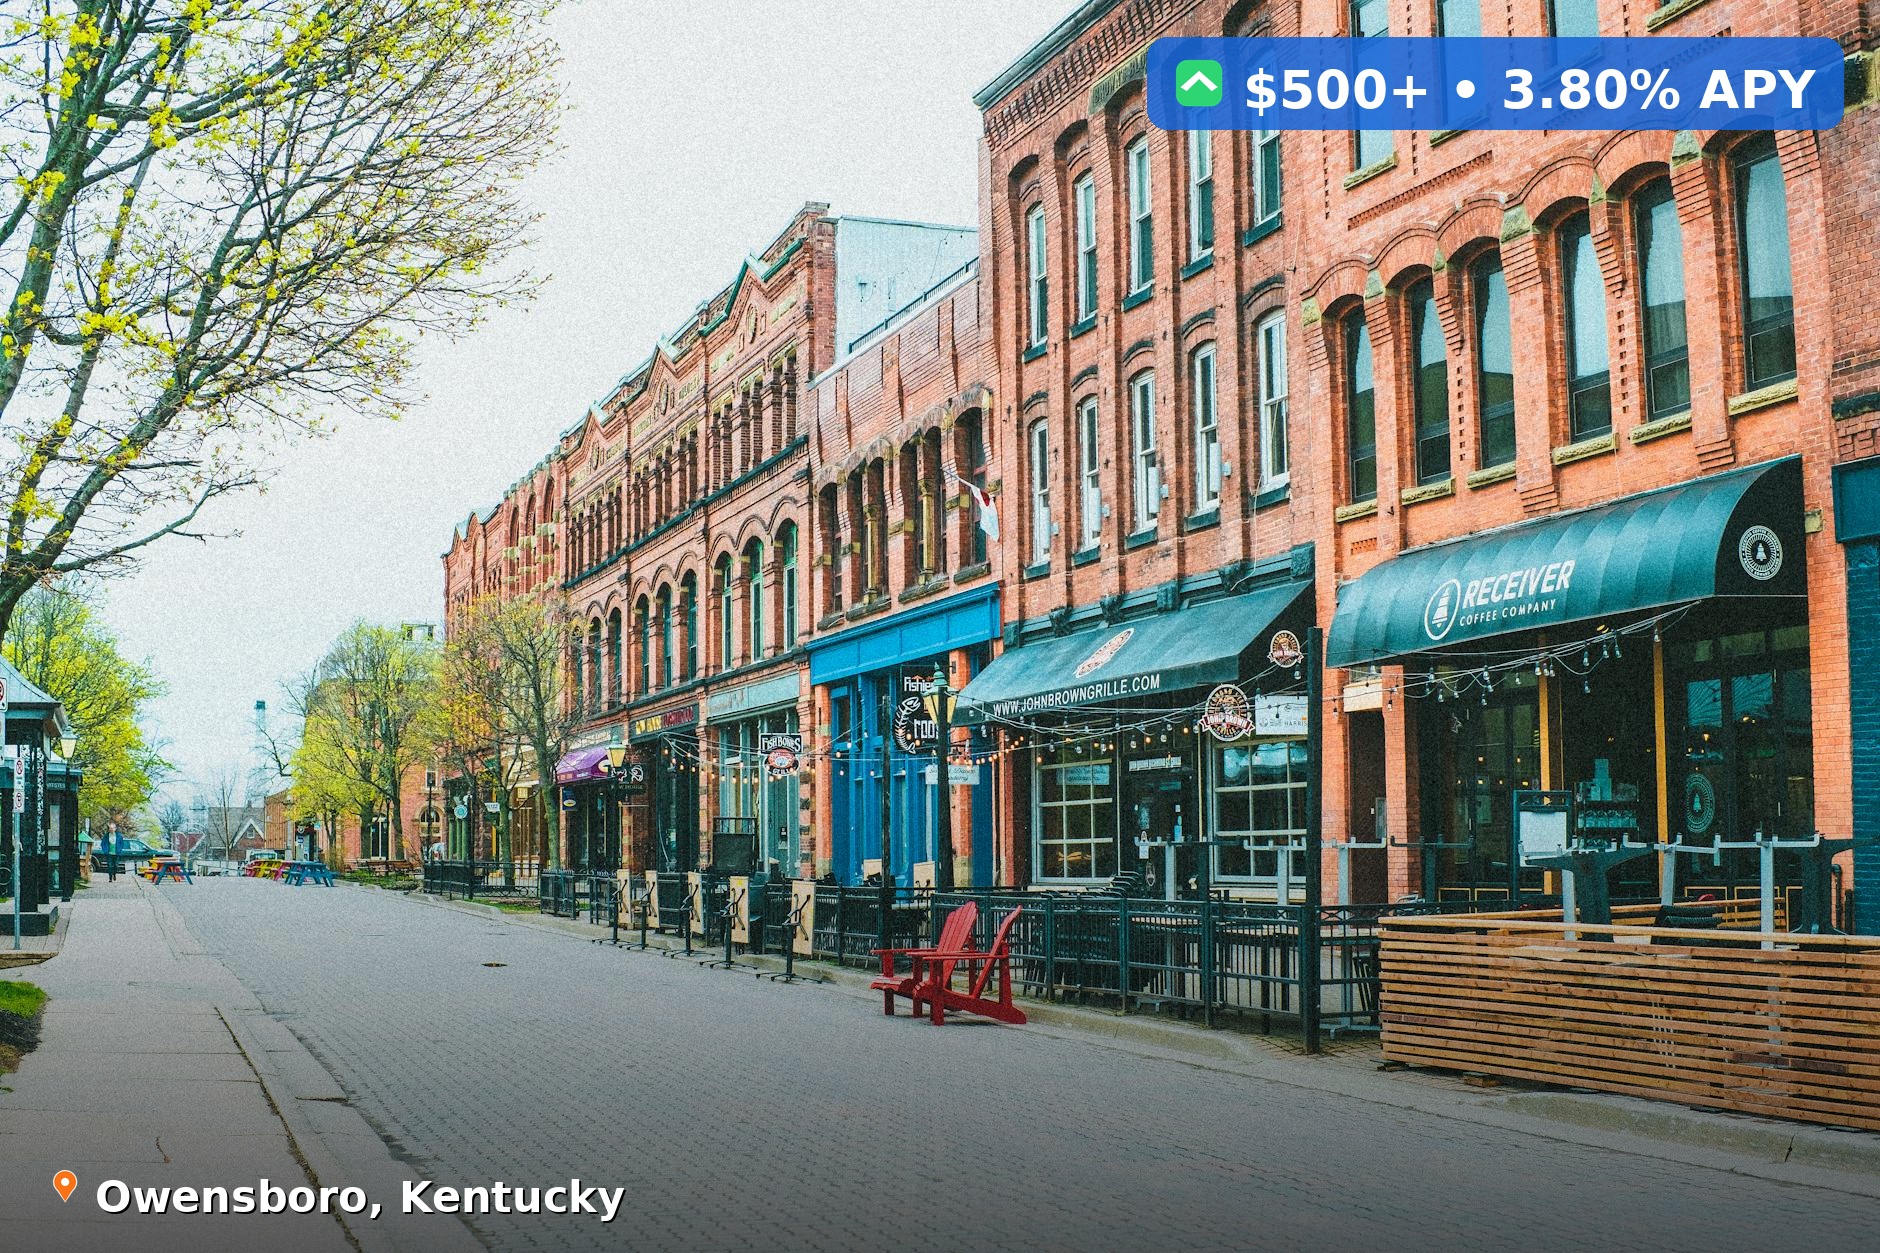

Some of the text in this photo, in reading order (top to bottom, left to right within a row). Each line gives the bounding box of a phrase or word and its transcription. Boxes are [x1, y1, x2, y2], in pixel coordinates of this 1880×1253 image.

[1462, 559, 1576, 609] RECEIVER
[1459, 598, 1557, 627] COFFEE COMPANY
[904, 676, 937, 692] Fishie
[993, 673, 1160, 716] WWW.JOHNBROWNGRILLE.COM
[914, 718, 939, 740] roo
